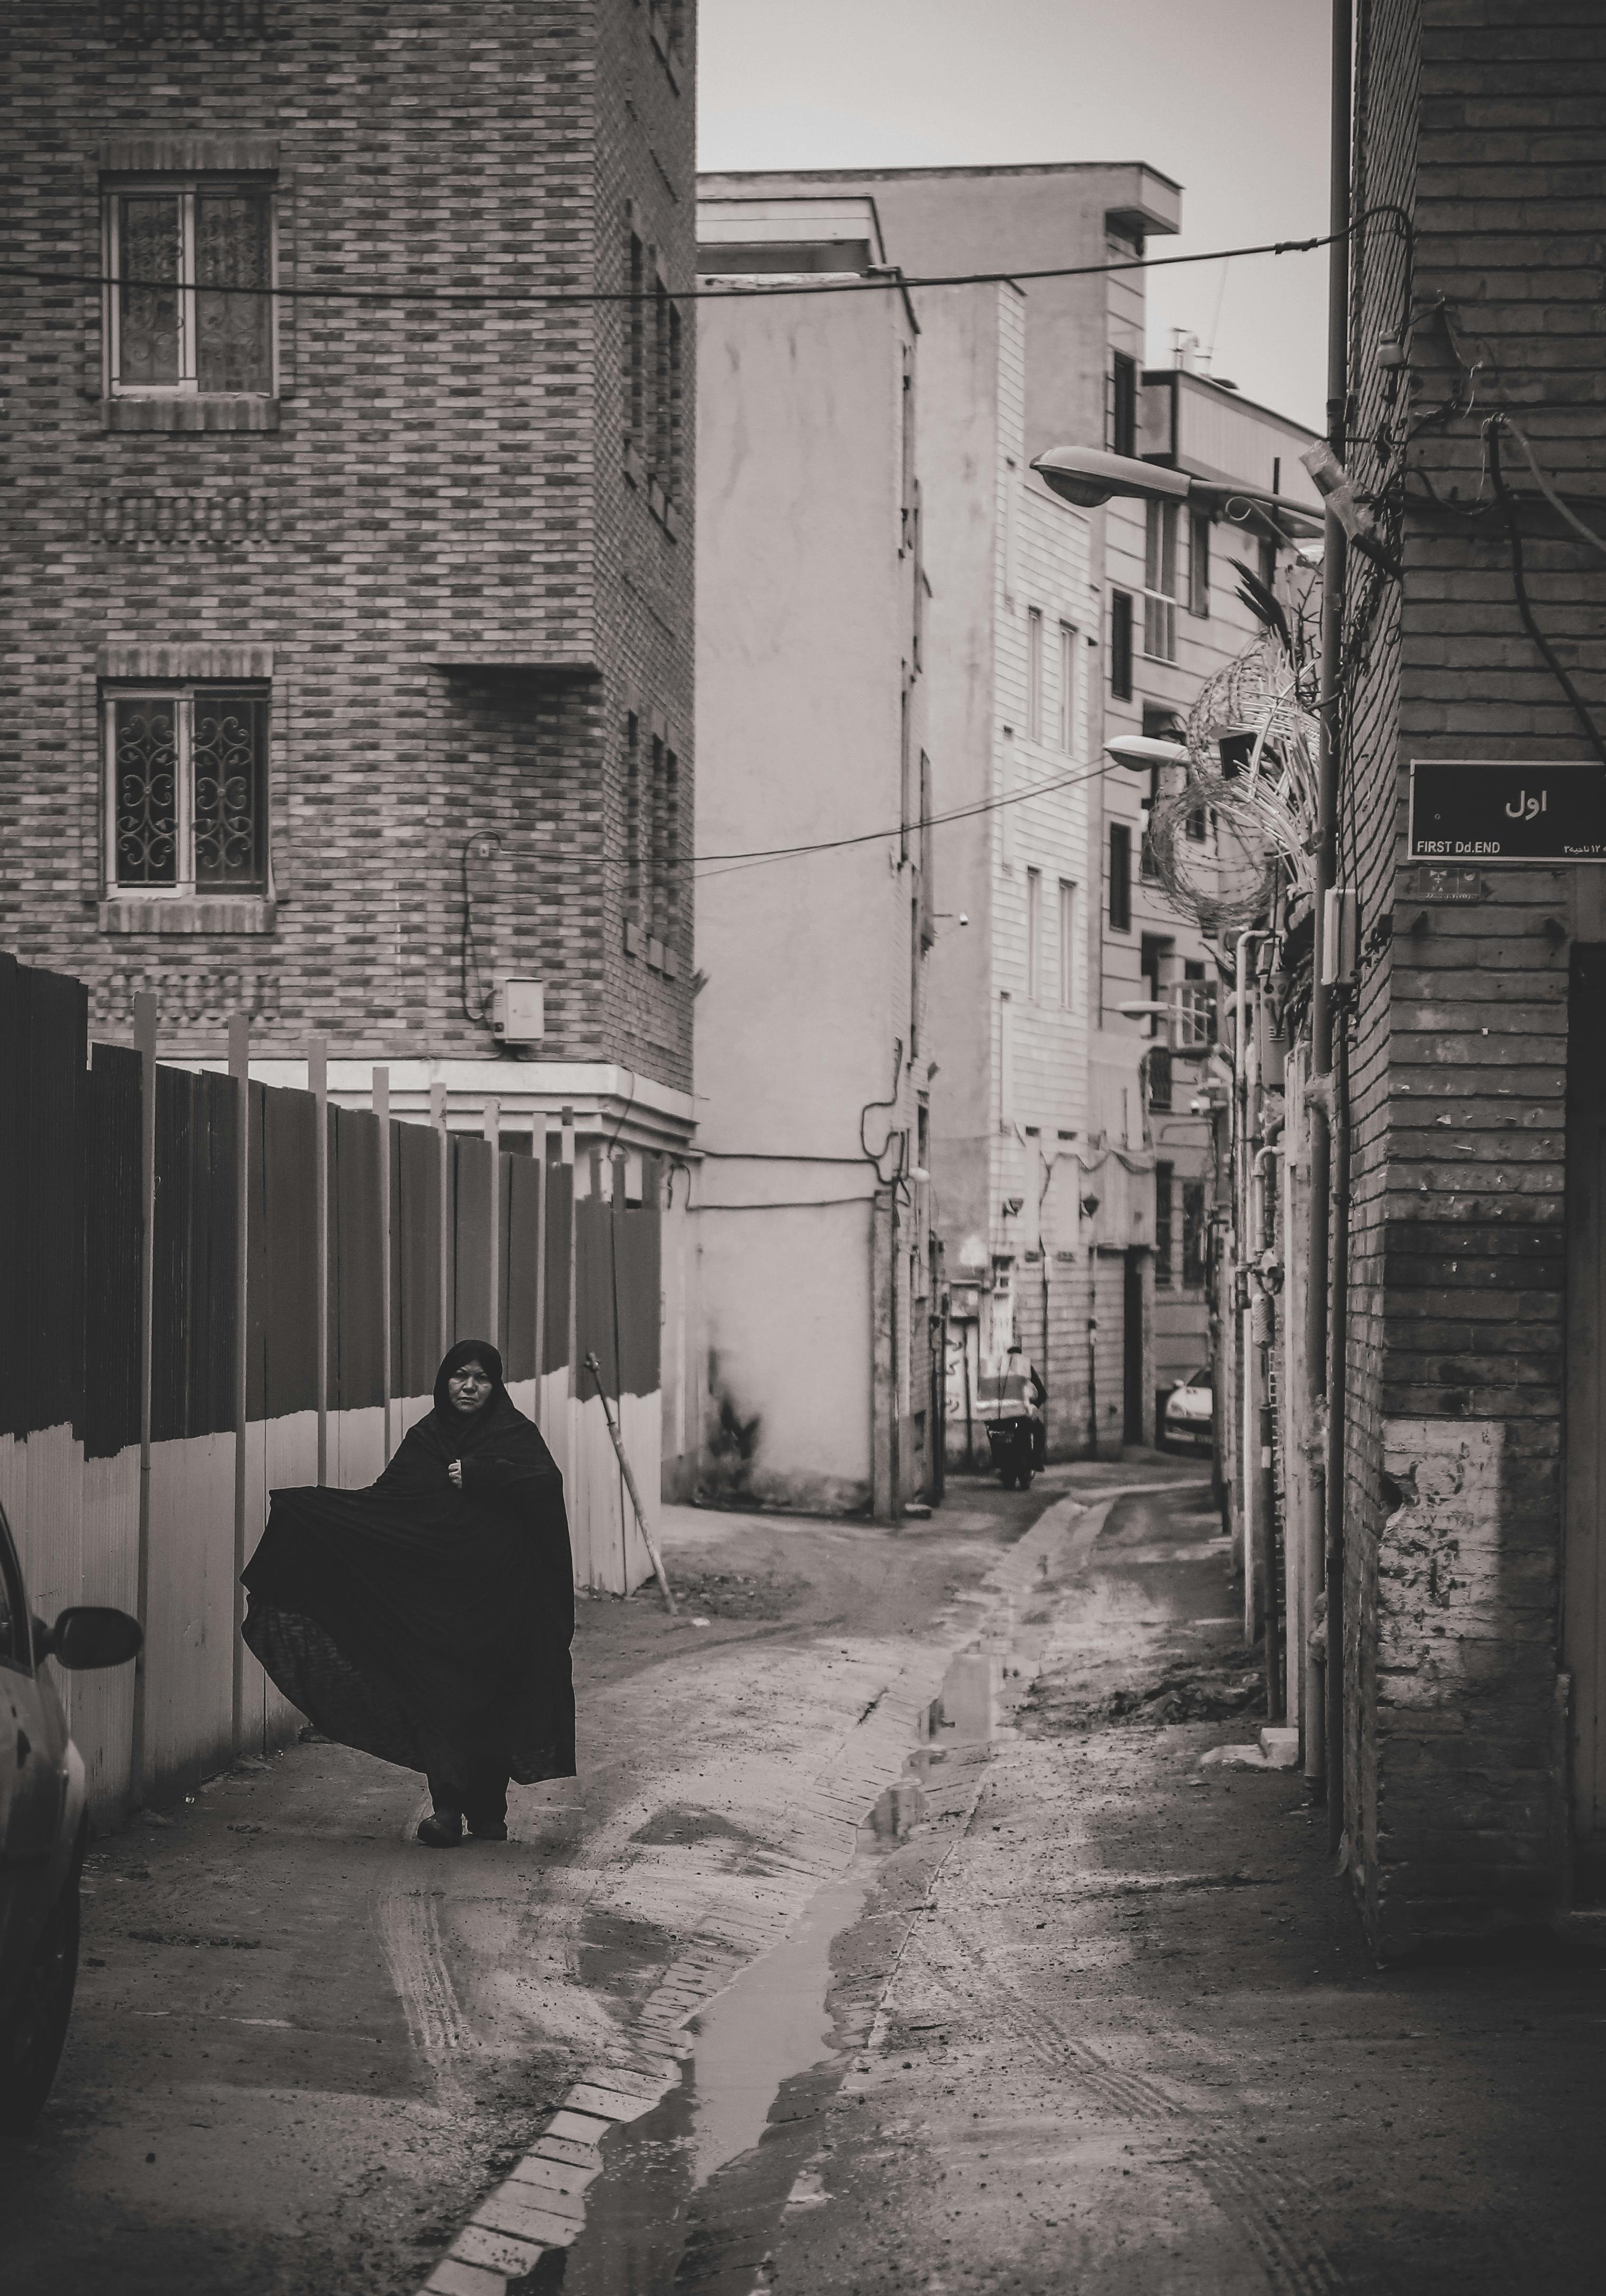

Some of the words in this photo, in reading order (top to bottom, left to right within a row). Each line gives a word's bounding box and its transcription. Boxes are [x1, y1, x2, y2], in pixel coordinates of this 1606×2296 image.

[1506, 790, 1547, 821] اول
[1417, 841, 1453, 853] FIRST
[1455, 841, 1501, 853] Dd.END
